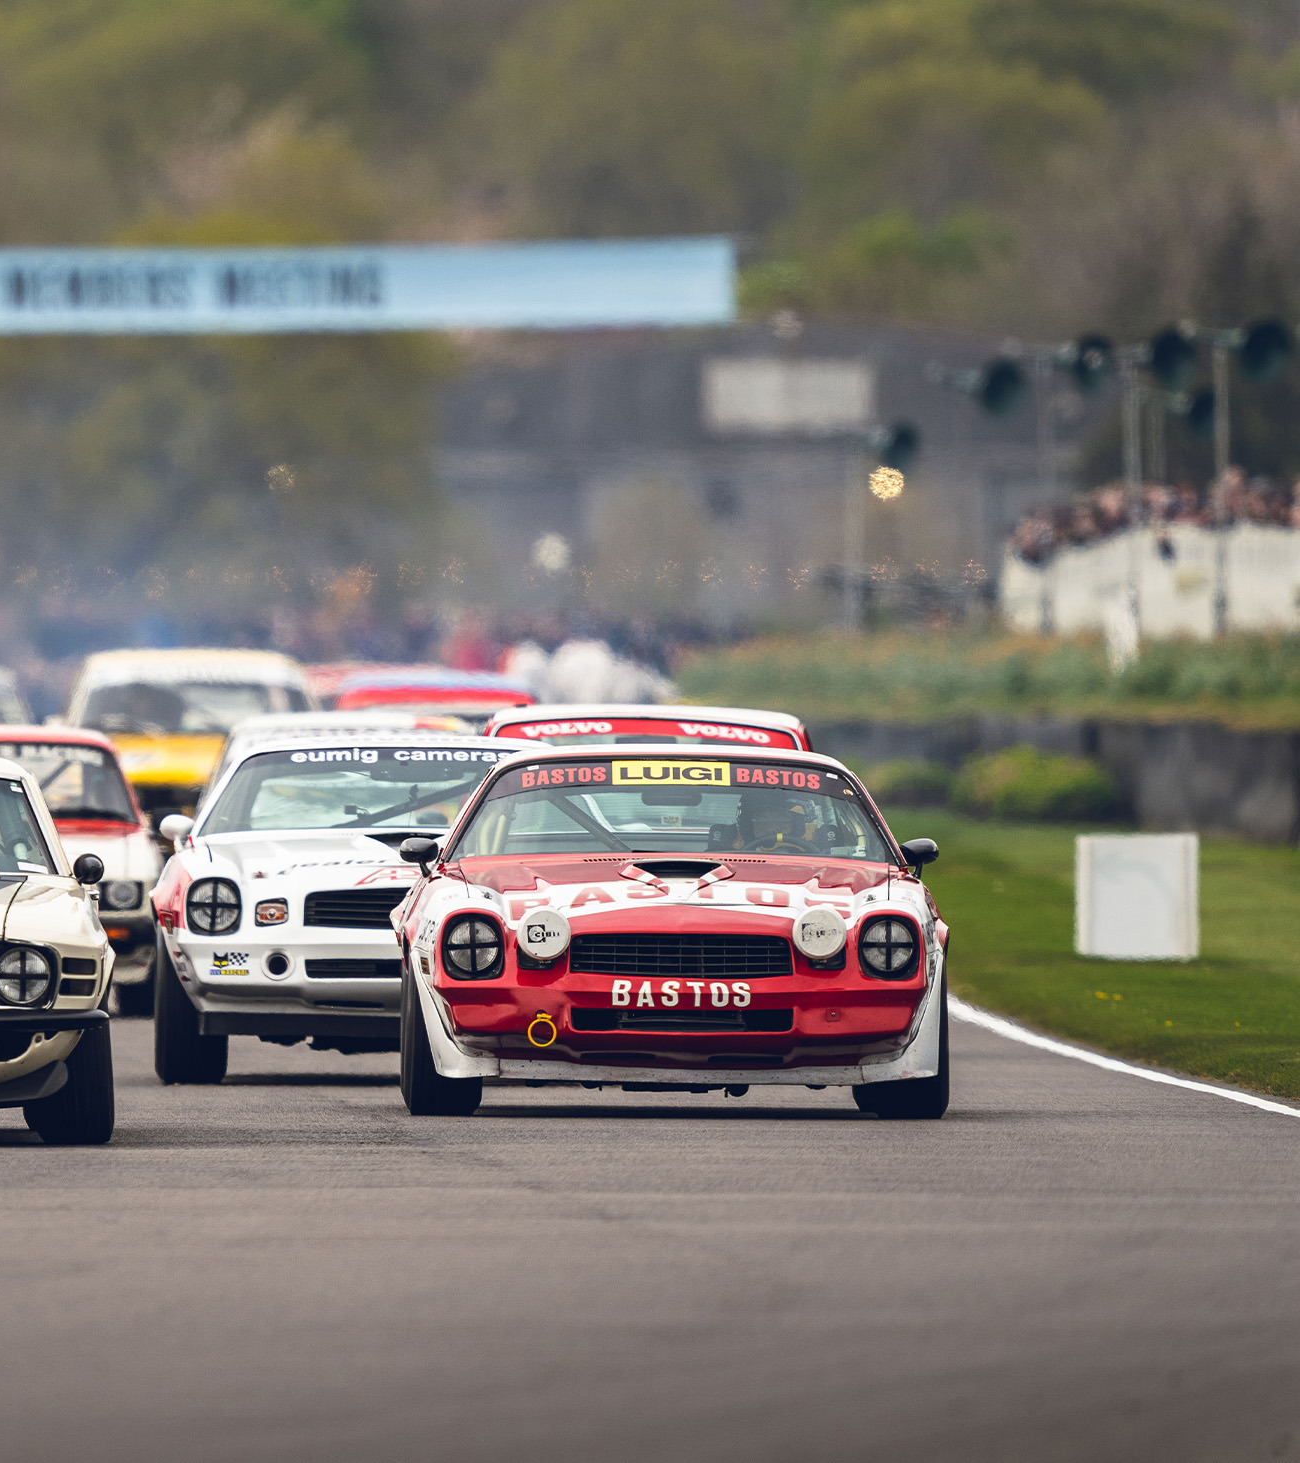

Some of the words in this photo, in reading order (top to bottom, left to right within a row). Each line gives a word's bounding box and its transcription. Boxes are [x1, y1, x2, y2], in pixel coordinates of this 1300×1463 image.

[521, 722, 612, 738] VOLVO
[678, 723, 770, 743] VOLVO
[290, 748, 378, 763] eumig
[394, 750, 512, 763] cameras
[522, 766, 606, 788] BASTOS
[620, 766, 722, 781] LUIGI
[736, 768, 820, 789] BASTOS
[611, 979, 751, 1008] BASTOS
